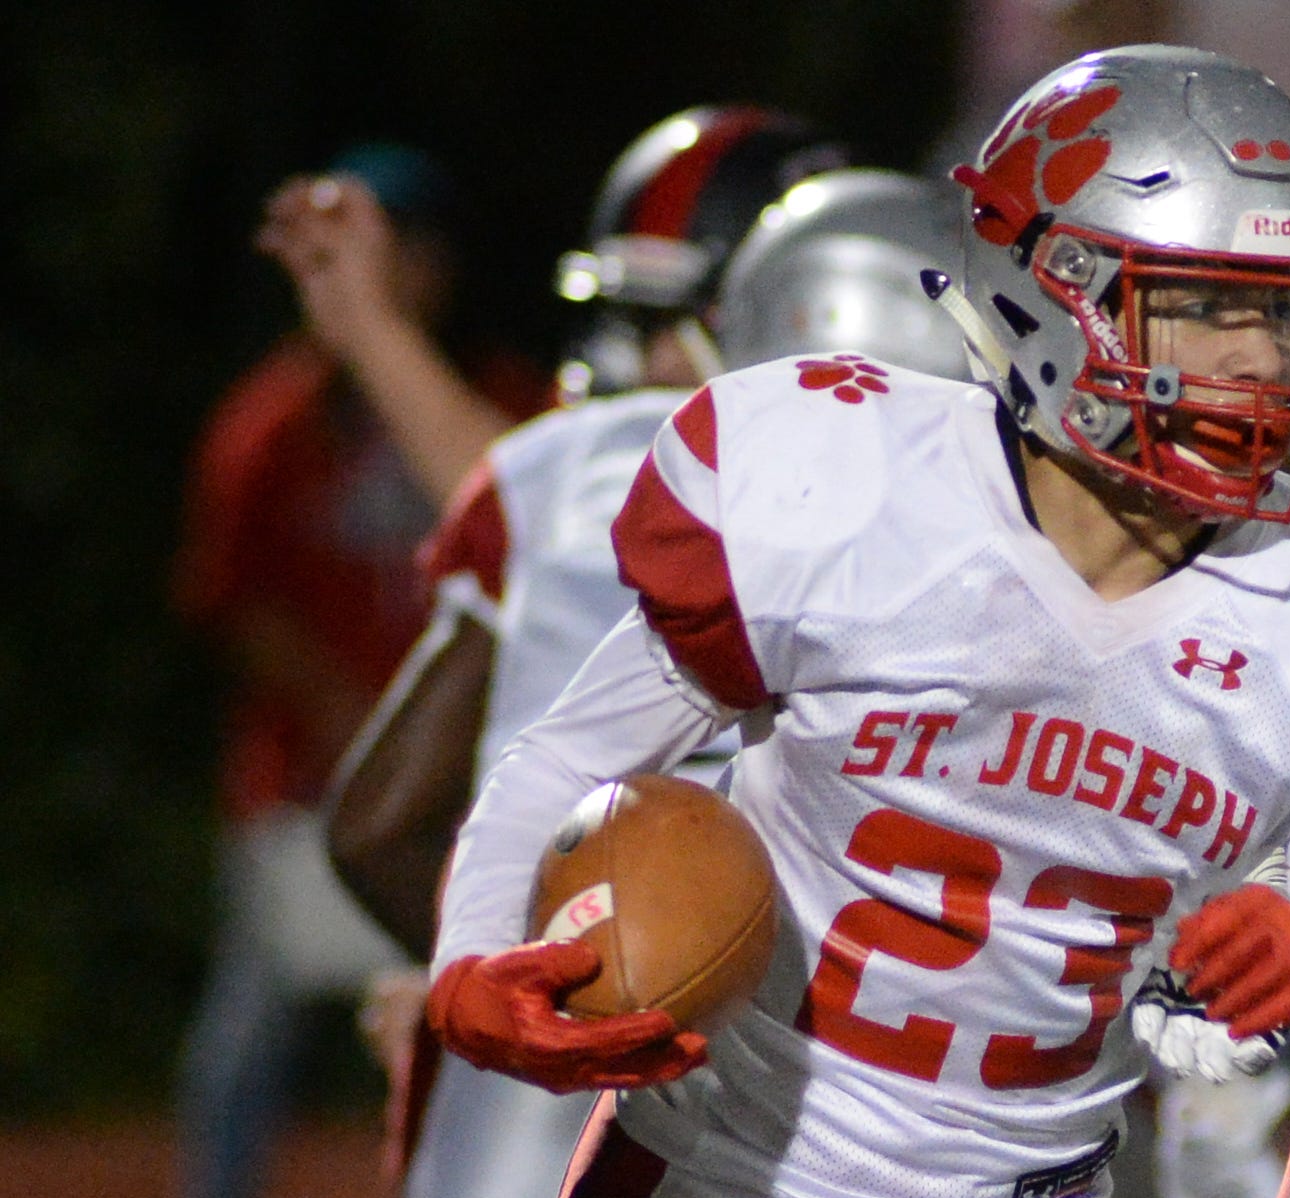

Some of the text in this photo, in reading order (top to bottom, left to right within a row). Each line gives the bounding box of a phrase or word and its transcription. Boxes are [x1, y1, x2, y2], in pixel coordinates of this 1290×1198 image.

[841, 710, 1258, 870] ST. JOSEPH
[794, 808, 1174, 1090] 23
